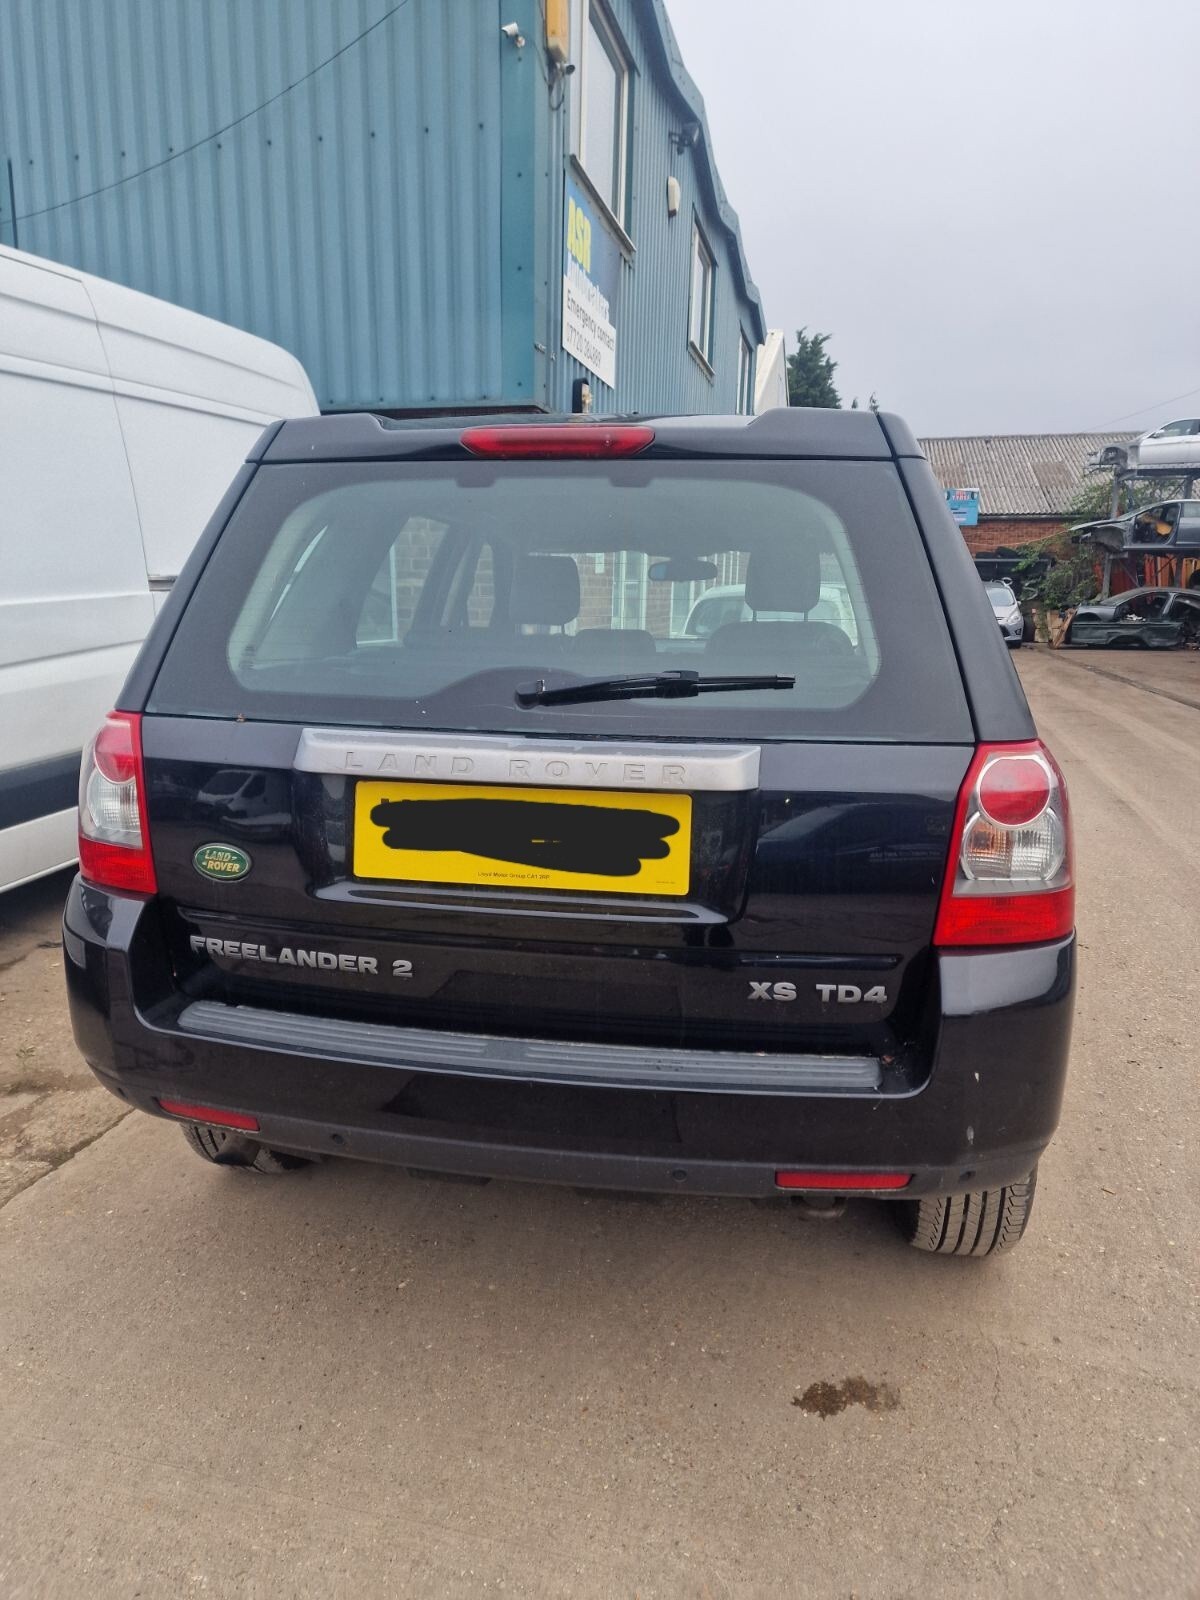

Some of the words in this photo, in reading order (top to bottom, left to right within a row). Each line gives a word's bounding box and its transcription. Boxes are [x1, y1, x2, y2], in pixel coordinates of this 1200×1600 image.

[566, 198, 591, 272] ASR
[567, 288, 597, 338] Emergency
[597, 324, 615, 351] contact
[344, 751, 475, 775] LAND
[508, 759, 688, 785] ROVER
[189, 935, 379, 975] FREELANDER
[392, 959, 413, 977] 2
[748, 981, 797, 1001] XS
[815, 983, 888, 1003] TD4
